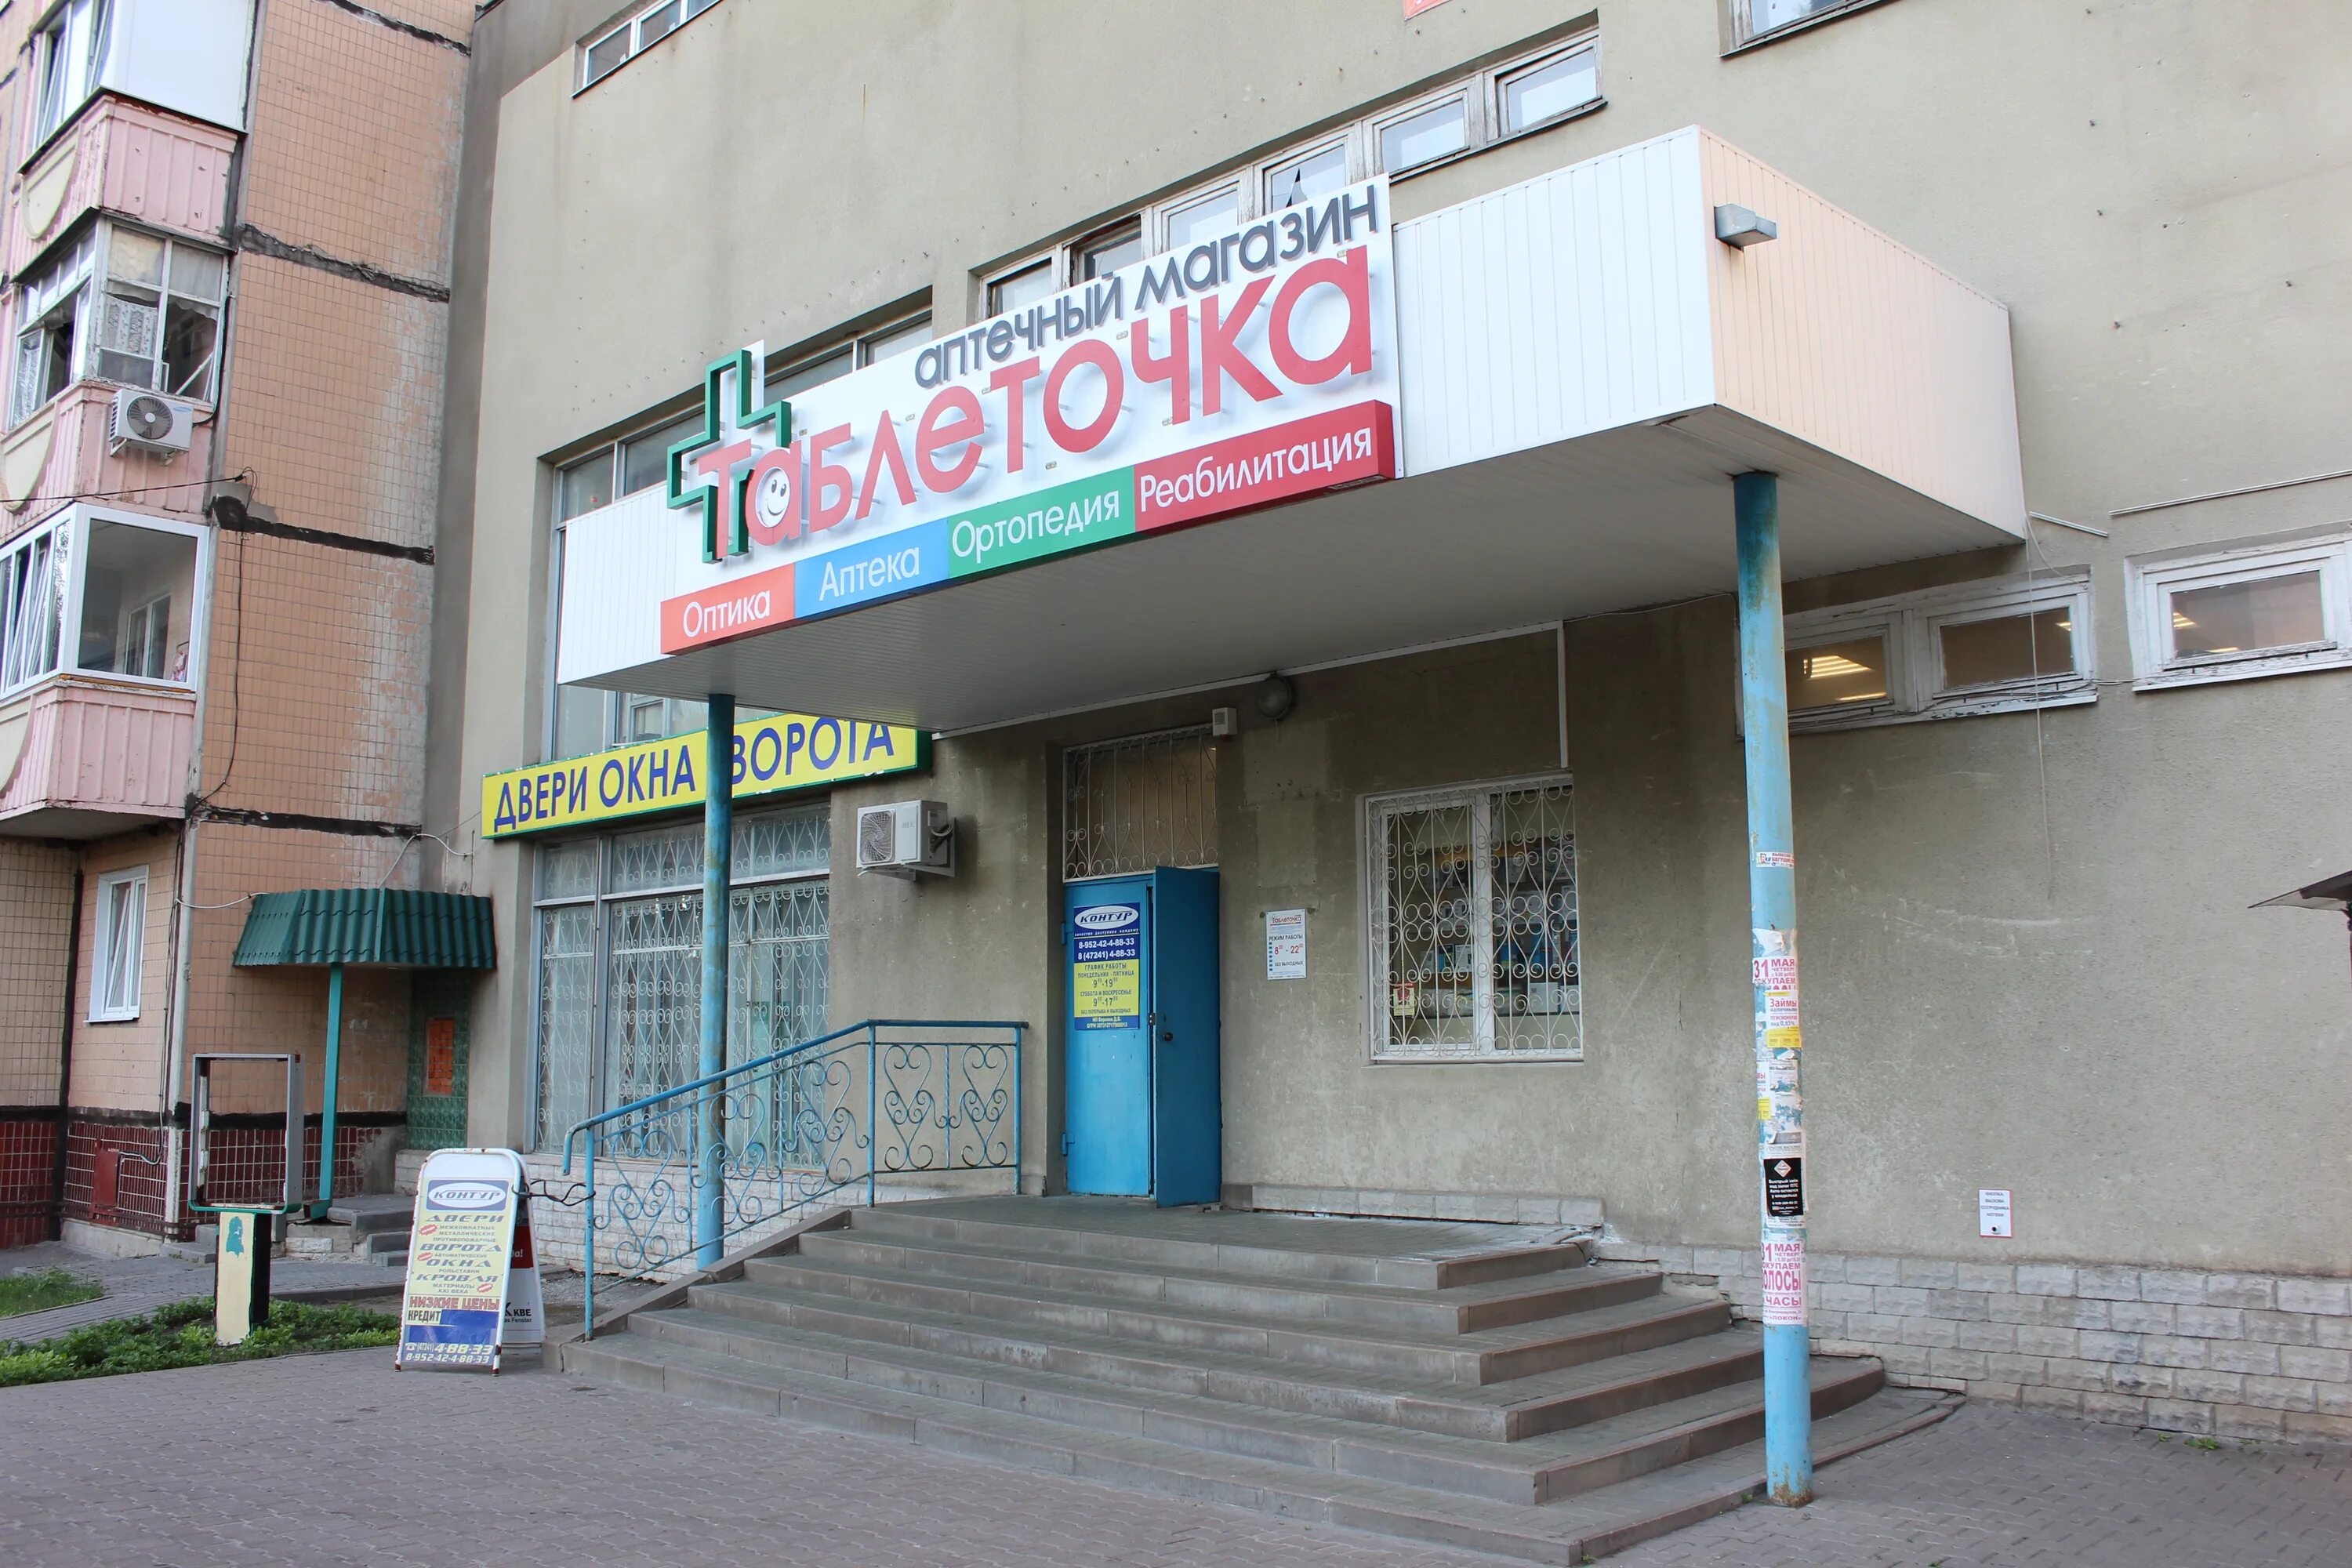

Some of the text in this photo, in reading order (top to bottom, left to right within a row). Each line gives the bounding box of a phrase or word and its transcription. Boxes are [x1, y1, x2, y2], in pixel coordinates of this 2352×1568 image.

[1140, 426, 1373, 513] Реабилитация
[952, 489, 1120, 564] Ортопедия
[818, 545, 920, 601] Аптека
[683, 589, 771, 638] Оптика
[494, 766, 588, 833] ДВЕРИ
[599, 745, 696, 808] ОКНА
[1080, 911, 1133, 924] КОНТУР
[1079, 938, 1134, 949] 8-952-42-4-88-33
[1083, 951, 1109, 961] (47241)
[1109, 949, 1136, 958] 4-88-33
[1754, 959, 1795, 978] 31 МАЯ
[1769, 998, 1797, 1007] Займы
[433, 1190, 502, 1200] КОНТУР
[426, 1214, 505, 1223] ДВЕРИ
[420, 1243, 502, 1252] ВОРОТА
[1774, 1243, 1800, 1252] МАЯ
[426, 1258, 492, 1268] ОКНА
[416, 1273, 499, 1283] КРОВЛЯ
[409, 1296, 501, 1311] НИЗКИЕ ЦЕНЫ
[1766, 1297, 1802, 1306] ЧАСЫ
[408, 1309, 441, 1323] КРЕДИТ
[514, 1308, 532, 1317] KBE
[417, 1342, 434, 1352] (47241)
